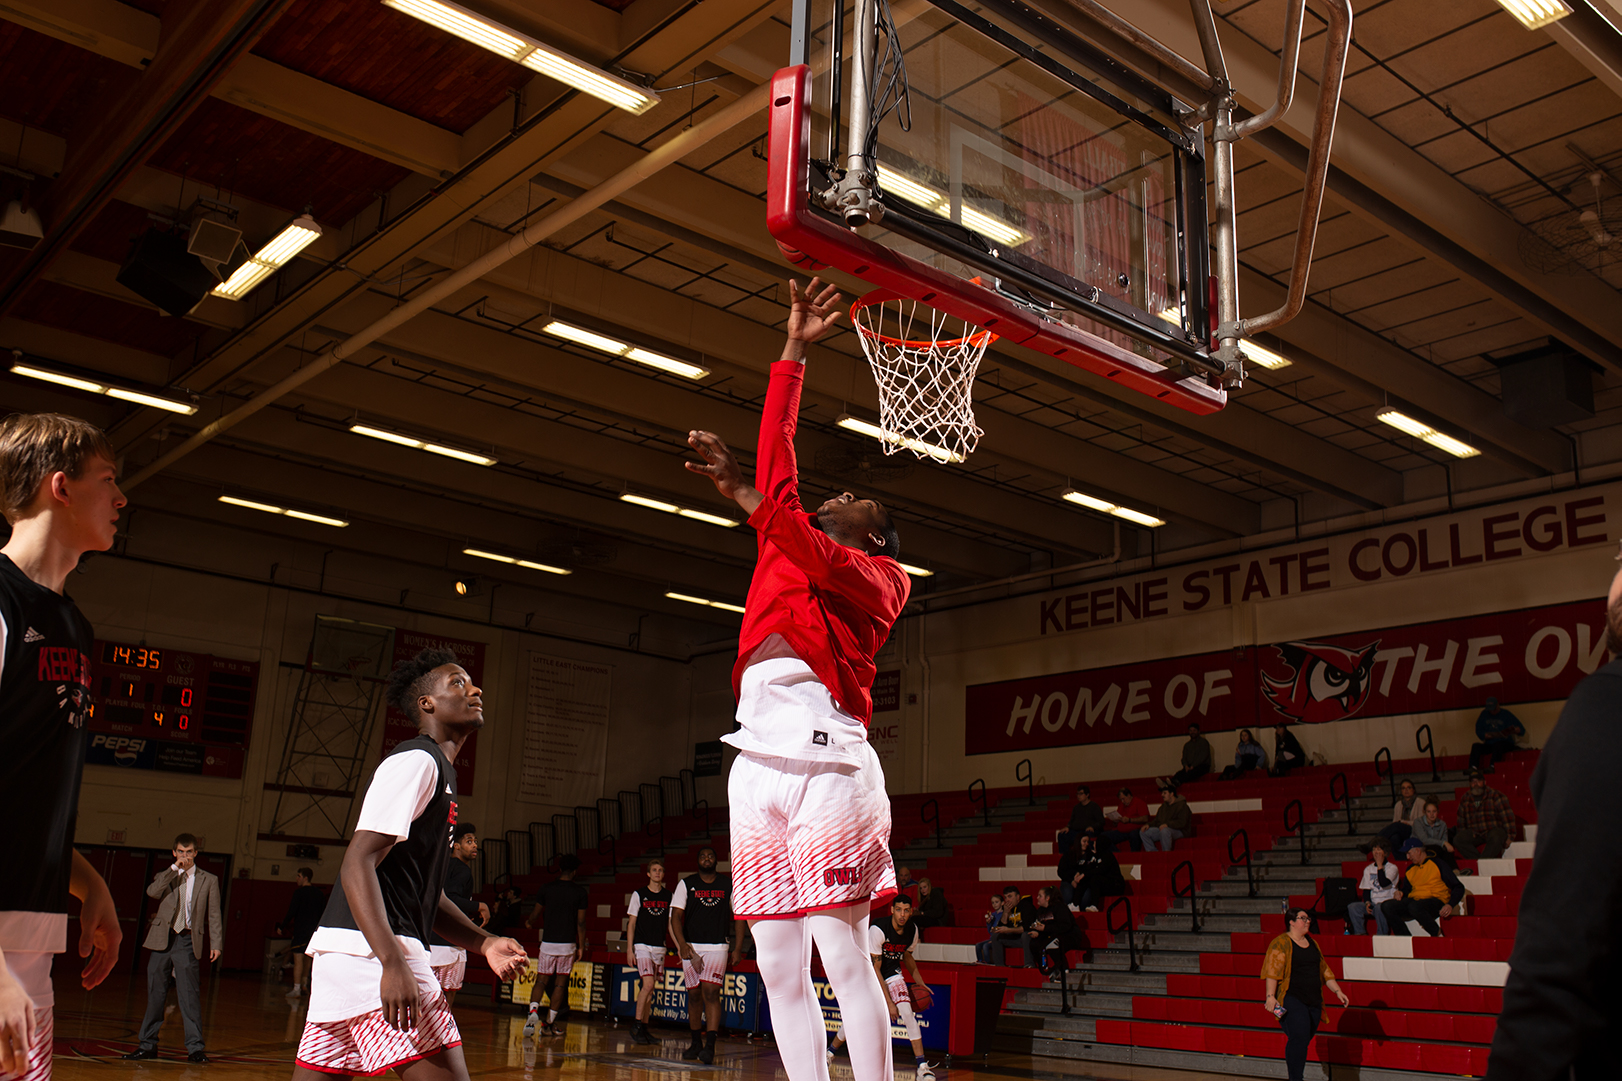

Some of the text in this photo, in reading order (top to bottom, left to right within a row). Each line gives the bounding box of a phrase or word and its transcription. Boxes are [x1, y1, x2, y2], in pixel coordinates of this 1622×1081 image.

[1040, 497, 1608, 635] KEENE STATE COLLEGE
[113, 645, 160, 670] 14:35
[533, 656, 608, 675] LITTLE EAST CHAMPIONS
[1374, 634, 1504, 698] THE
[119, 673, 141, 682] PERIOD
[166, 674, 195, 686] GUEST
[128, 682, 134, 697] 1
[105, 694, 128, 707] PLAYER
[130, 701, 146, 709] FOUL
[180, 688, 193, 708] 0
[874, 696, 896, 706] 2-3103
[1005, 669, 1233, 737] HOME OF
[174, 706, 193, 715] FOULS
[154, 712, 164, 726] 4
[178, 714, 189, 730] 0
[112, 724, 133, 733] MATCH
[170, 730, 190, 740] SCORE
[91, 735, 147, 753] PEPSI
[111, 832, 123, 840] EXIT
[650, 991, 686, 1008] CREEN
[653, 1006, 666, 1018] Best
[666, 1008, 680, 1020] Way
